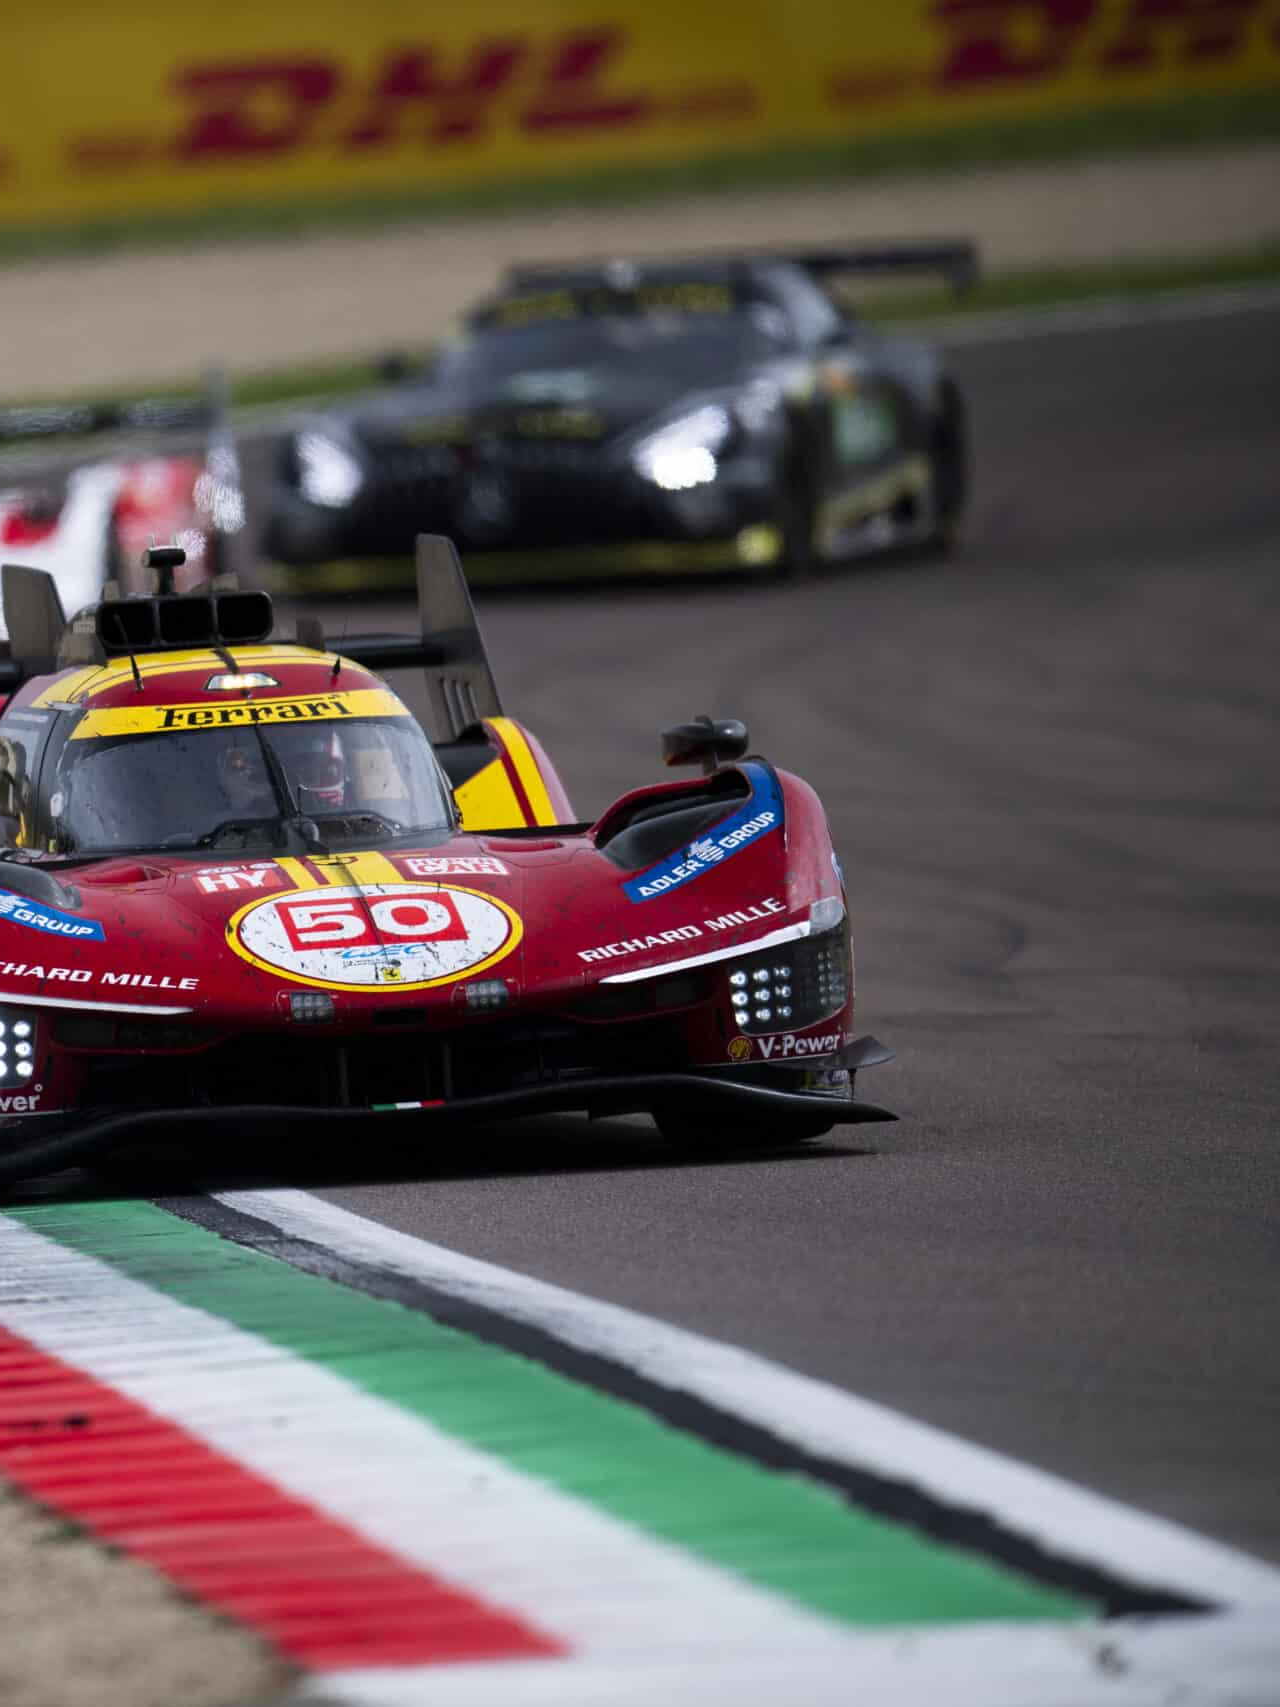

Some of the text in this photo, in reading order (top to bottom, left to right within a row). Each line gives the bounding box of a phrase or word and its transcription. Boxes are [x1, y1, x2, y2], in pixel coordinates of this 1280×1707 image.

[923, 0, 1280, 96] DH
[172, 26, 650, 165] DHL
[155, 694, 353, 729] Ferrari
[638, 811, 775, 897] ADLER GROUP
[197, 869, 266, 893] HY
[13, 907, 94, 936] GROUP
[287, 898, 452, 943] 50
[577, 898, 786, 962] RICHARD MILLE
[100, 971, 199, 991] MILLE
[758, 1034, 840, 1058] V-Power
